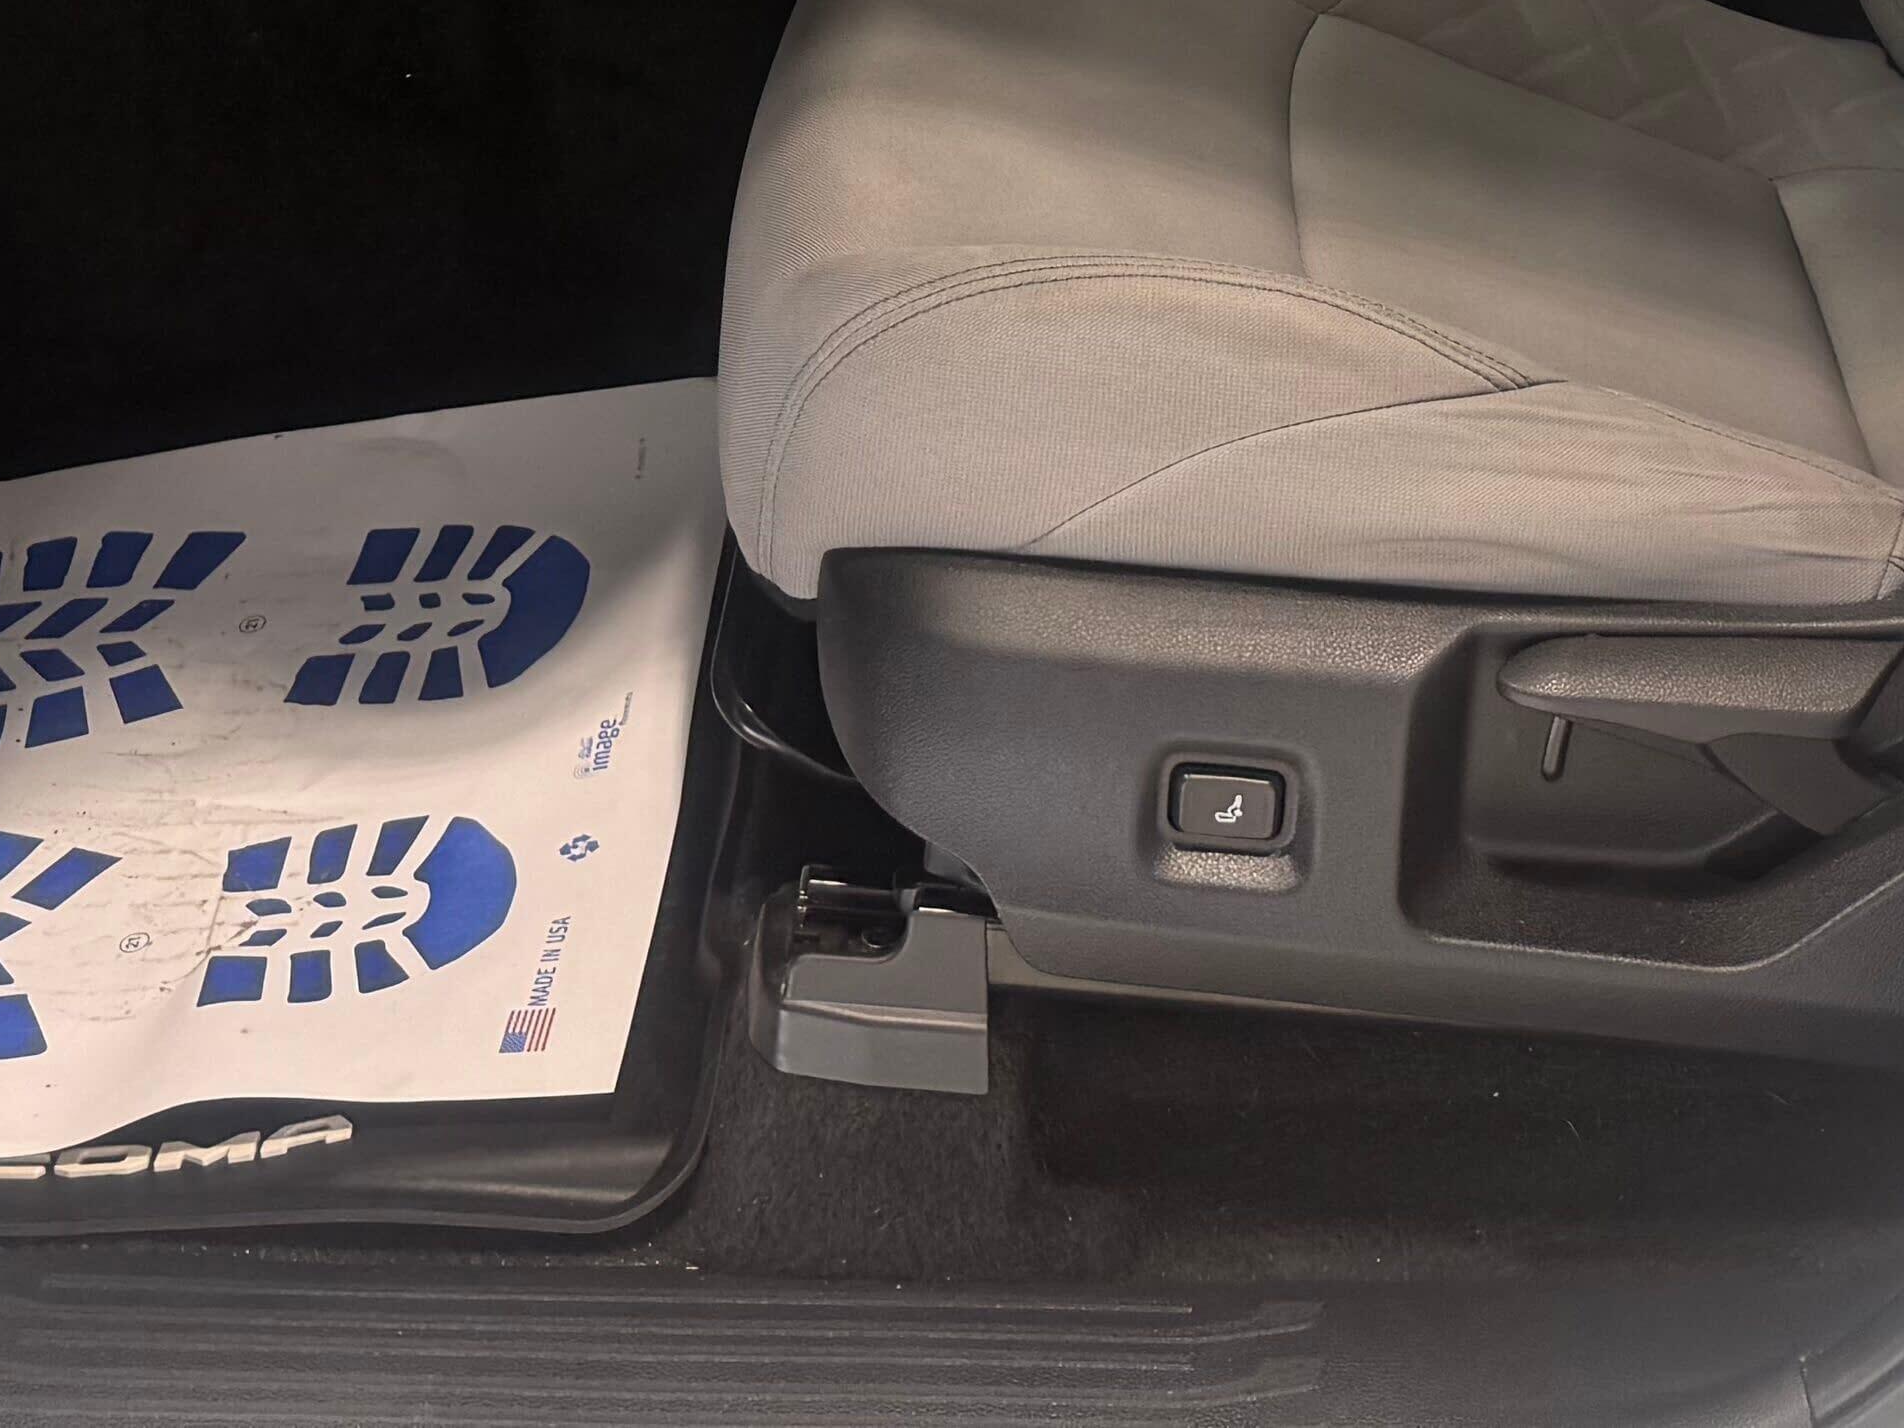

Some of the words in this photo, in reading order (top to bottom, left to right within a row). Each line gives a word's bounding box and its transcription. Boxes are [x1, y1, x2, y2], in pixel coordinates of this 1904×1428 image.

[546, 915, 571, 944] USA
[540, 948, 561, 963] IN
[528, 966, 557, 1007] MADE
